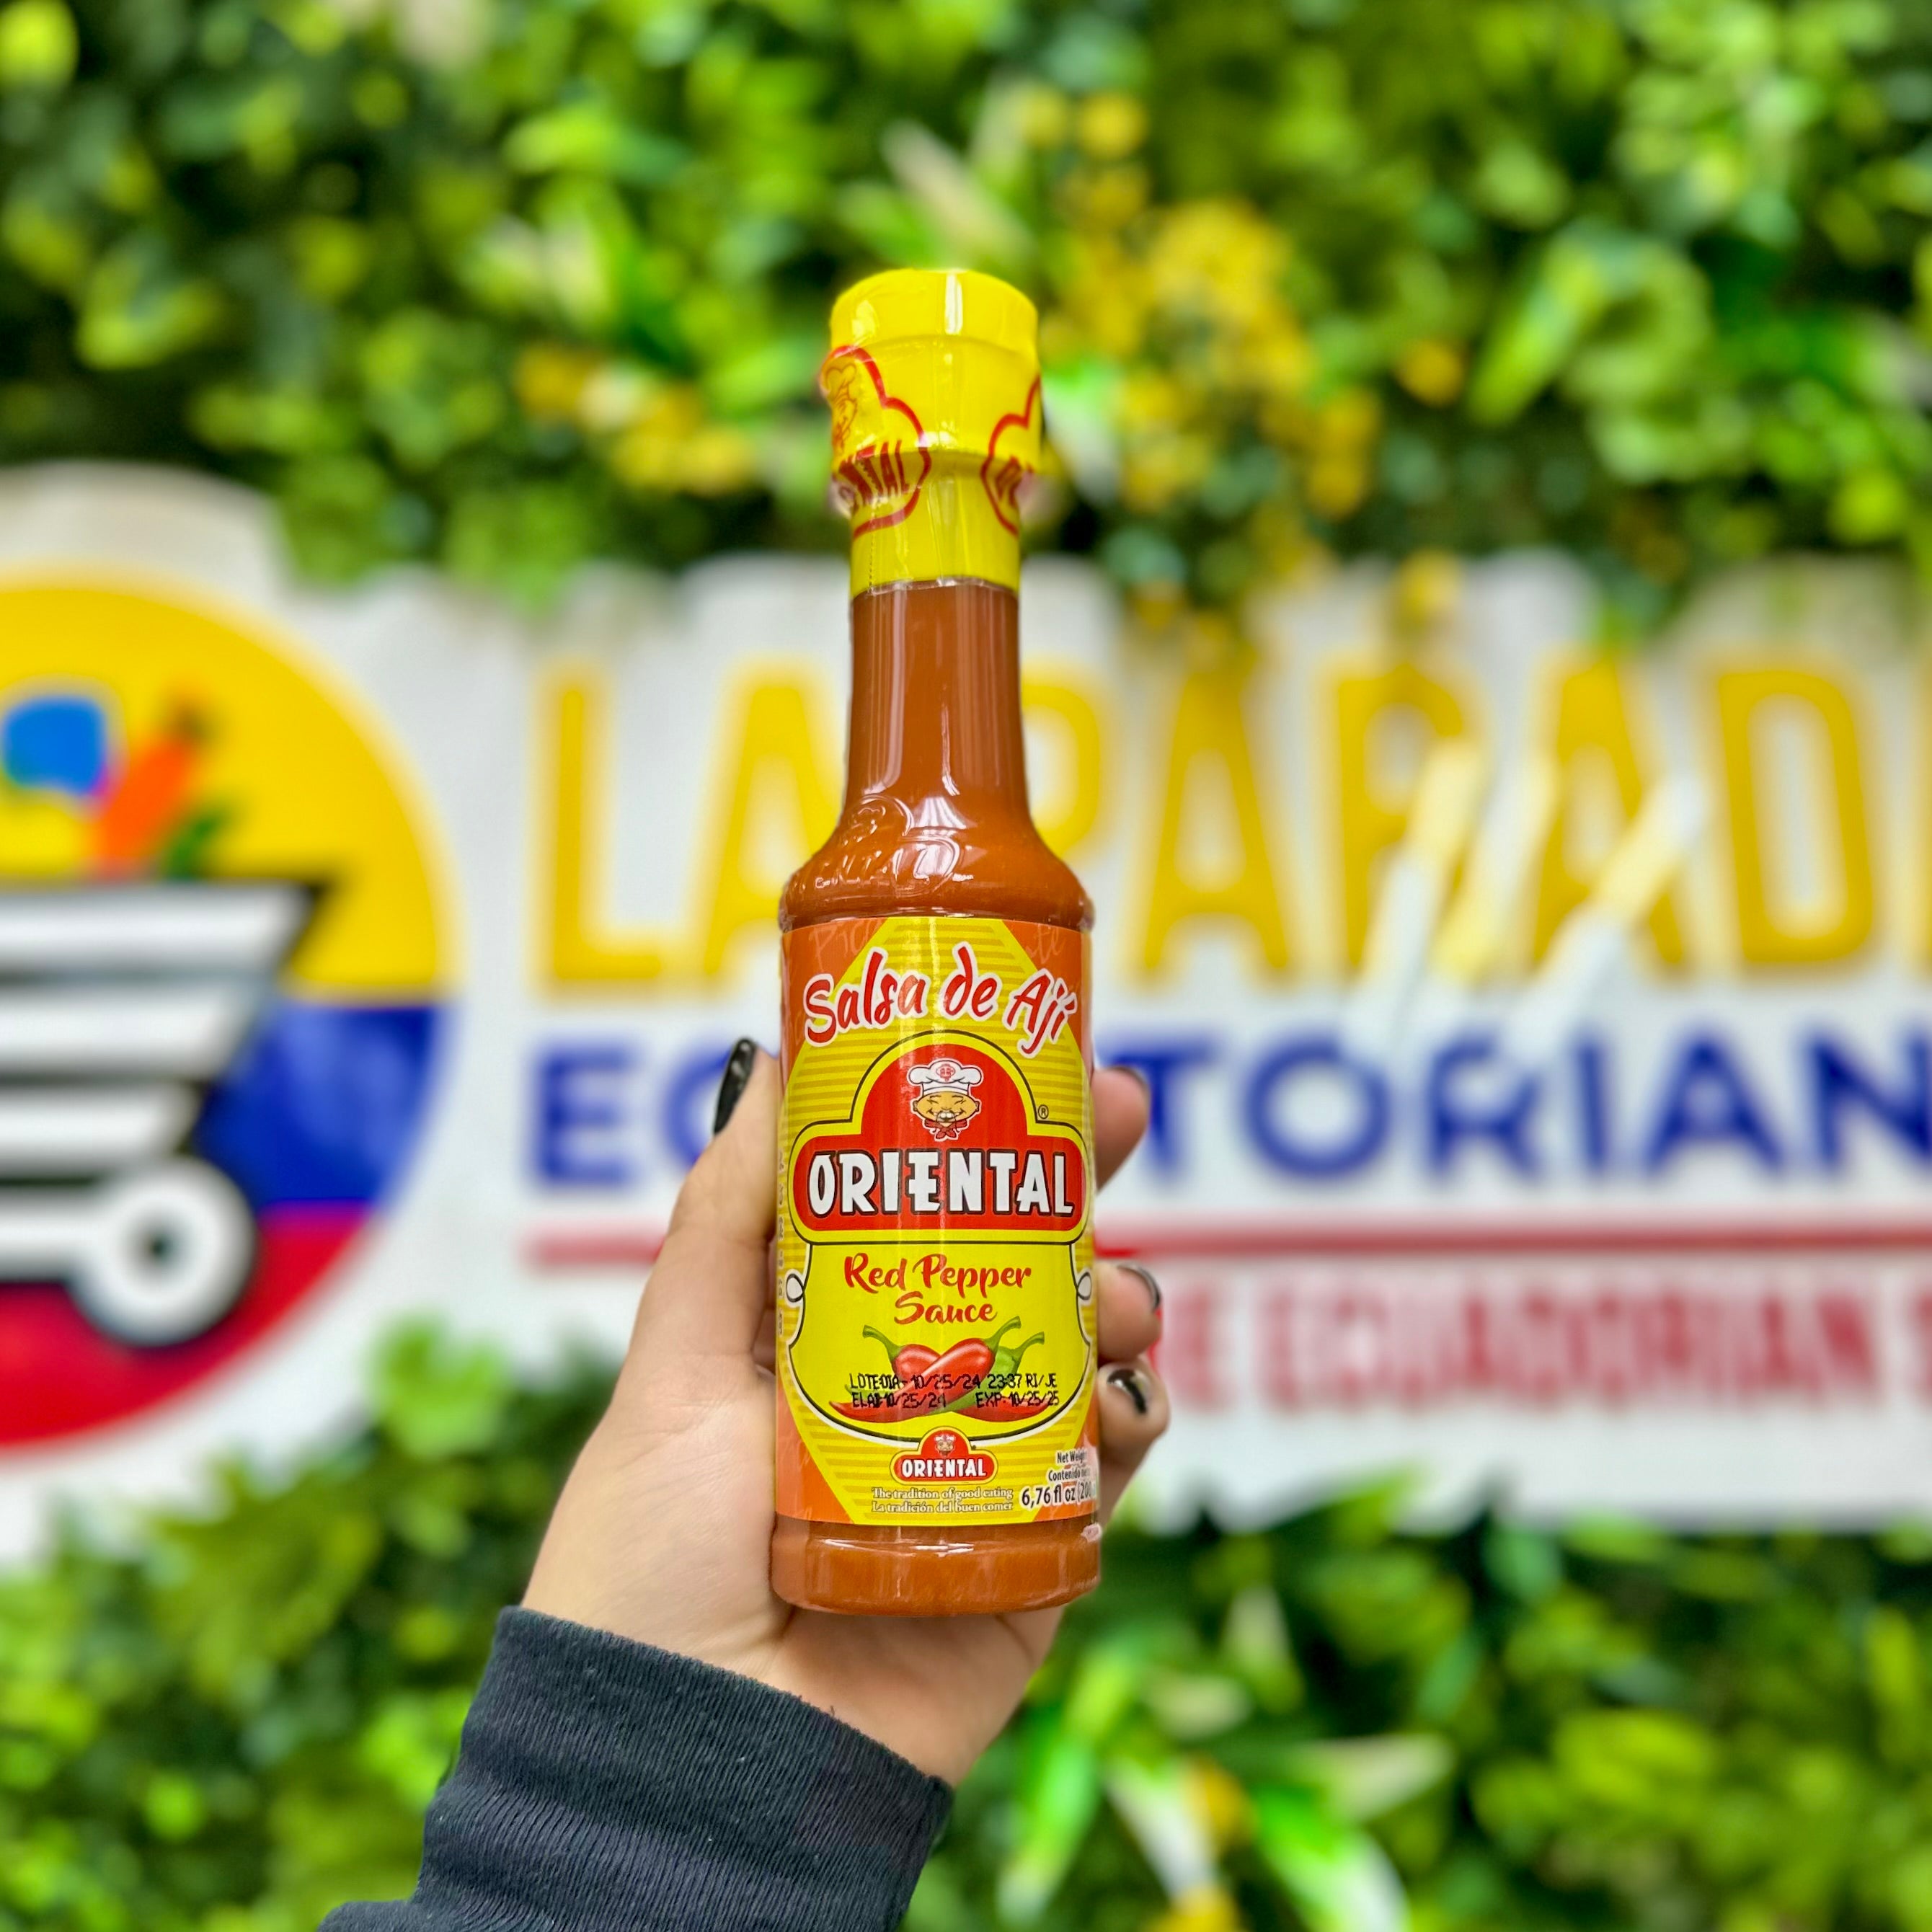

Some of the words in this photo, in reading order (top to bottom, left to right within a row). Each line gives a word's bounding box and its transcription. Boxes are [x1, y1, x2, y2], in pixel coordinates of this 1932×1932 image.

[805, 949, 929, 1045] Salsa
[944, 945, 998, 1019] de
[1006, 973, 1076, 1054] Ají
[808, 1151, 1074, 1215] ORIENTAL
[844, 1252, 908, 1293] Red
[912, 1253, 1032, 1299] Pepper
[894, 1290, 998, 1325] Sauce
[902, 1458, 987, 1478] ORIENTAL
[1057, 1451, 1068, 1463] Net
[1048, 1468, 1080, 1481] Contenido
[872, 1486, 892, 1499] The
[893, 1487, 940, 1499] tradition
[941, 1486, 954, 1499] of
[954, 1486, 981, 1502] good
[983, 1486, 1014, 1499] eating
[1022, 1486, 1050, 1509] 6,76
[1053, 1484, 1062, 1503] fl
[1065, 1487, 1076, 1502] oz
[872, 1500, 886, 1512] La
[887, 1500, 934, 1512] tradición
[936, 1500, 953, 1512] del
[954, 1499, 981, 1512] buen
[983, 1502, 1014, 1512] comer
